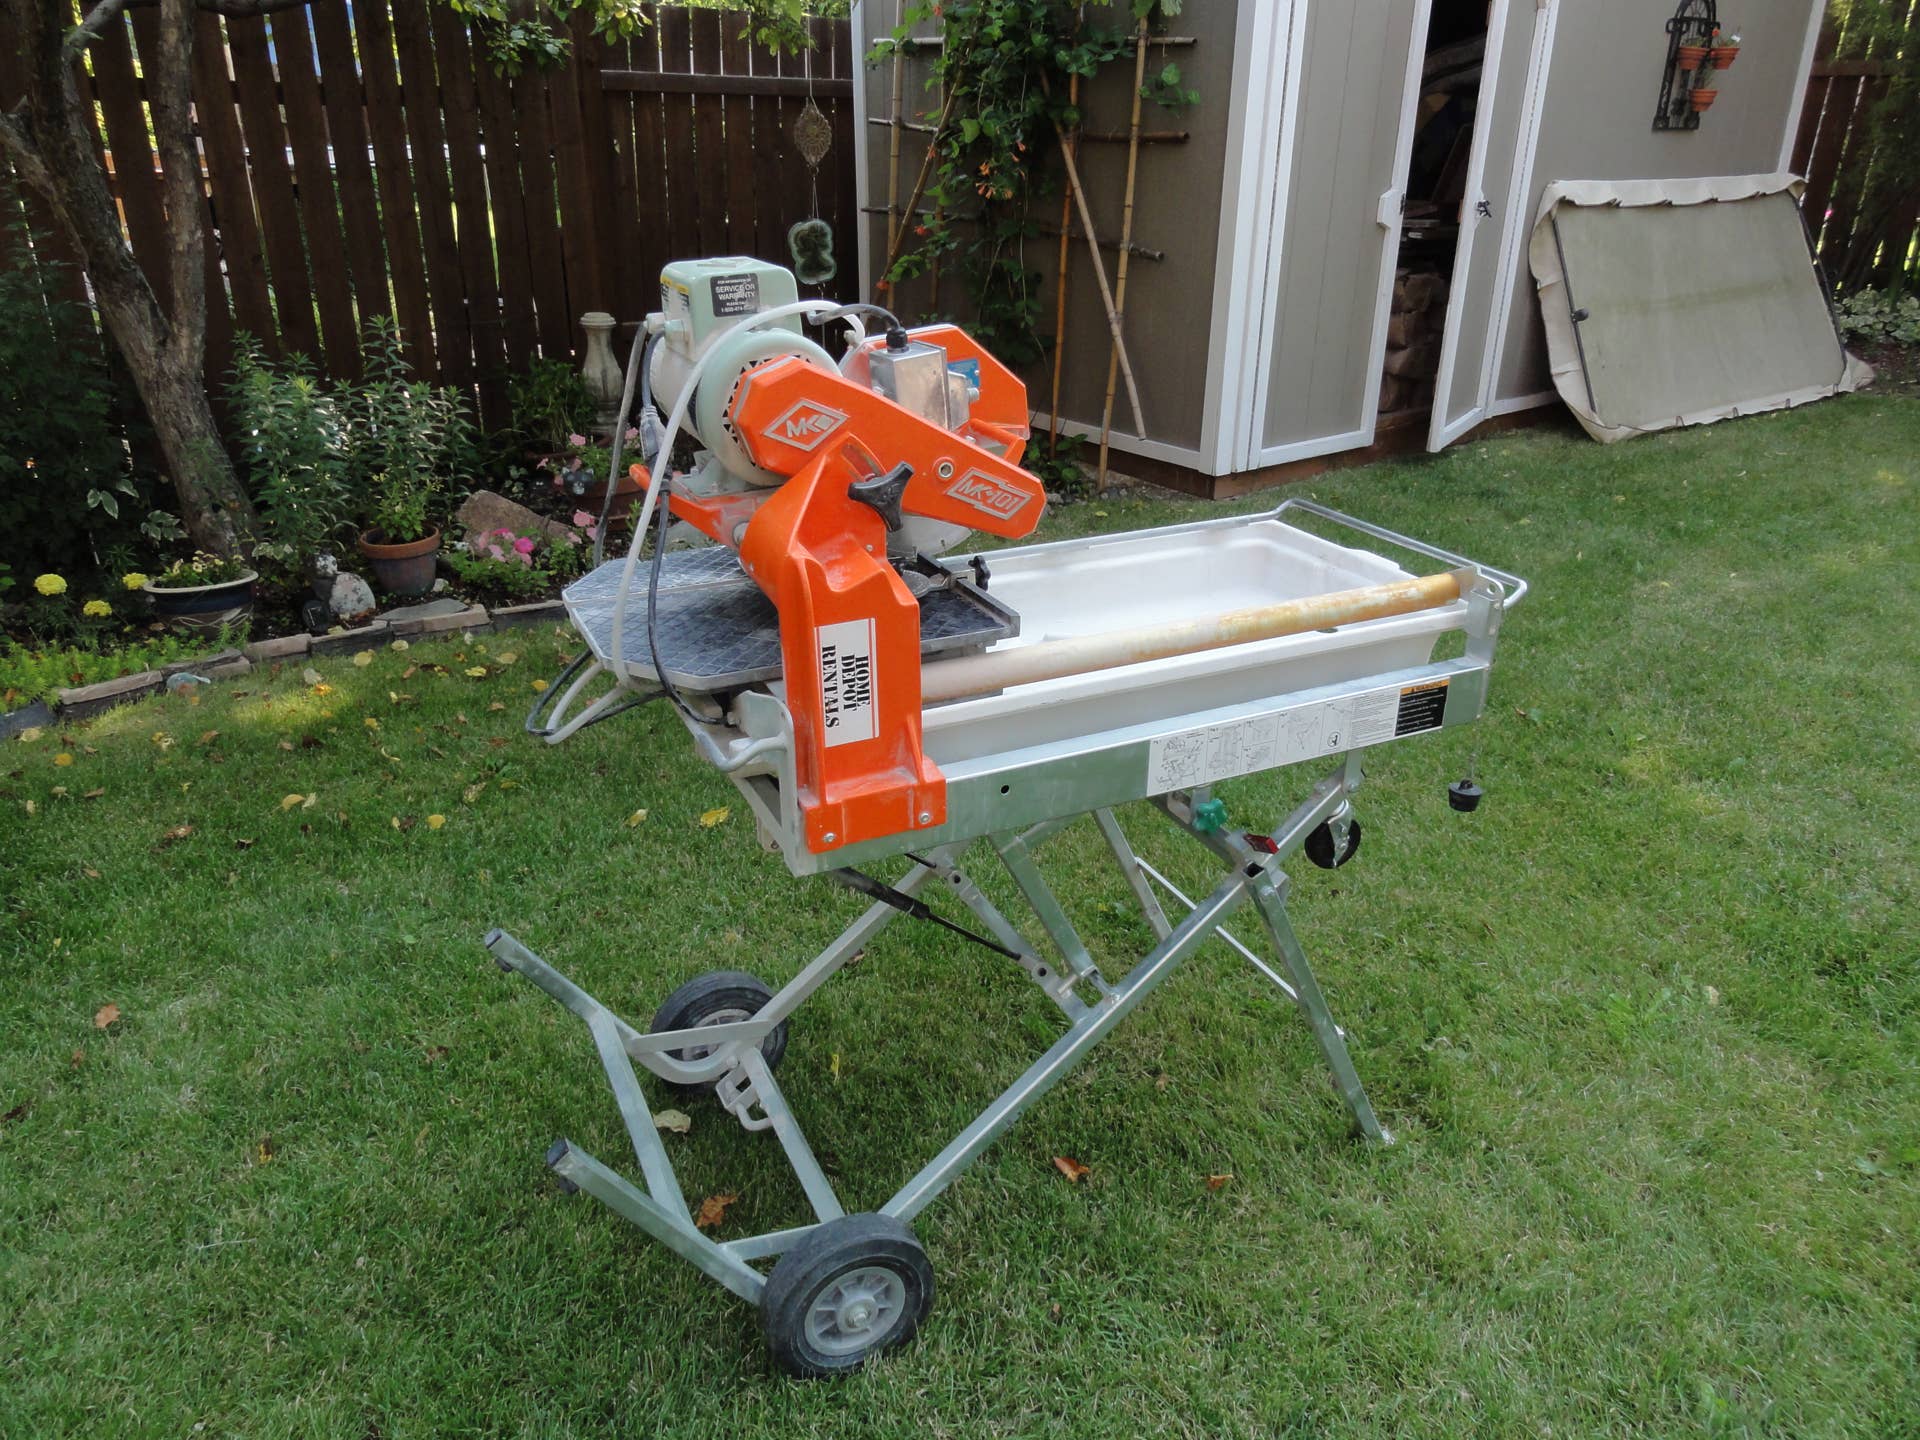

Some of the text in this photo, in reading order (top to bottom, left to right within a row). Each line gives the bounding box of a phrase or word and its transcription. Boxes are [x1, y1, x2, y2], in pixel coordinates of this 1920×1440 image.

[715, 283, 756, 294] SERVICE OR
[822, 644, 840, 728] RENTALS
[841, 654, 857, 712] DEPOT
[855, 655, 870, 707] HOME
